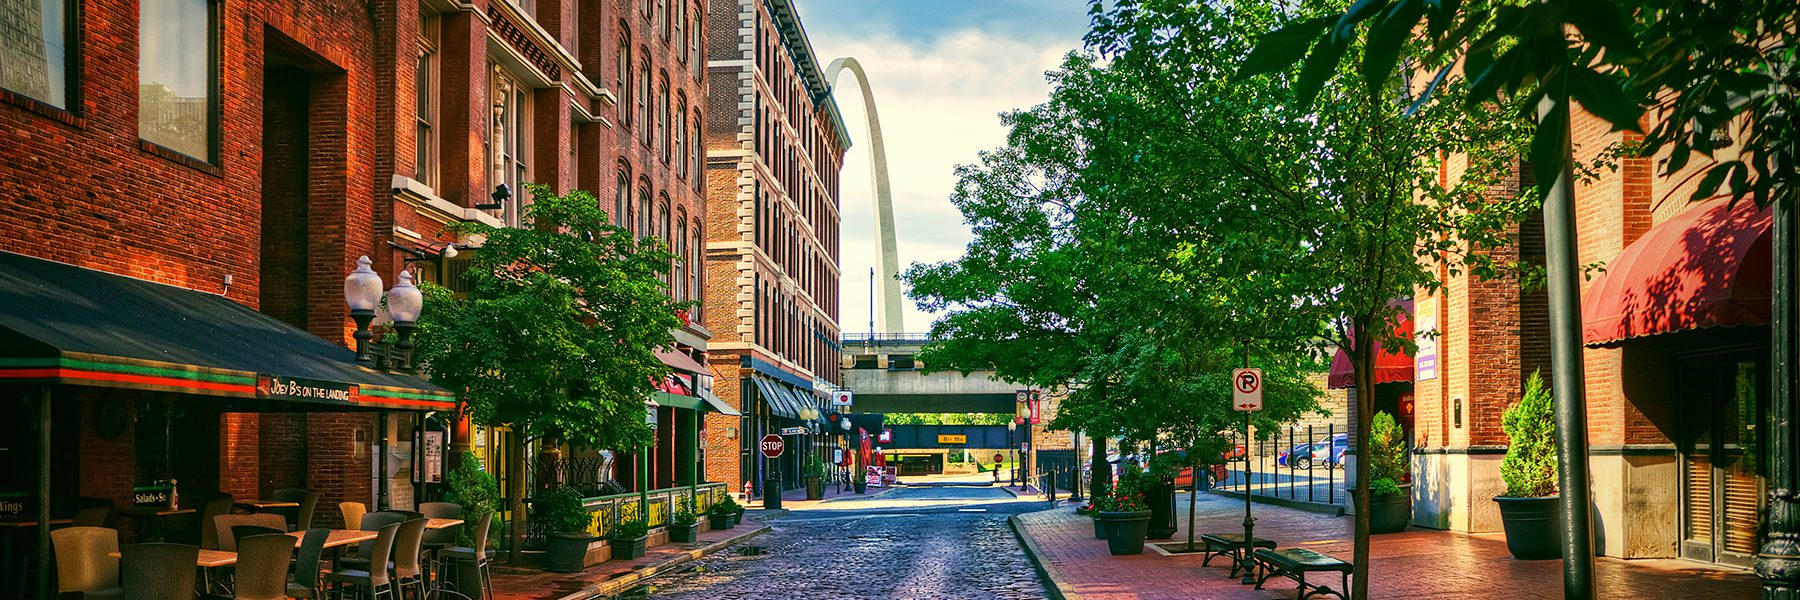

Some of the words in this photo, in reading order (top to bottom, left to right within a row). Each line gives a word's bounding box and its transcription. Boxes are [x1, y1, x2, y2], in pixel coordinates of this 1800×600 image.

[302, 386, 312, 397] ON
[313, 387, 325, 398] THE
[326, 389, 349, 401] LANDING
[762, 442, 782, 450] STOP
